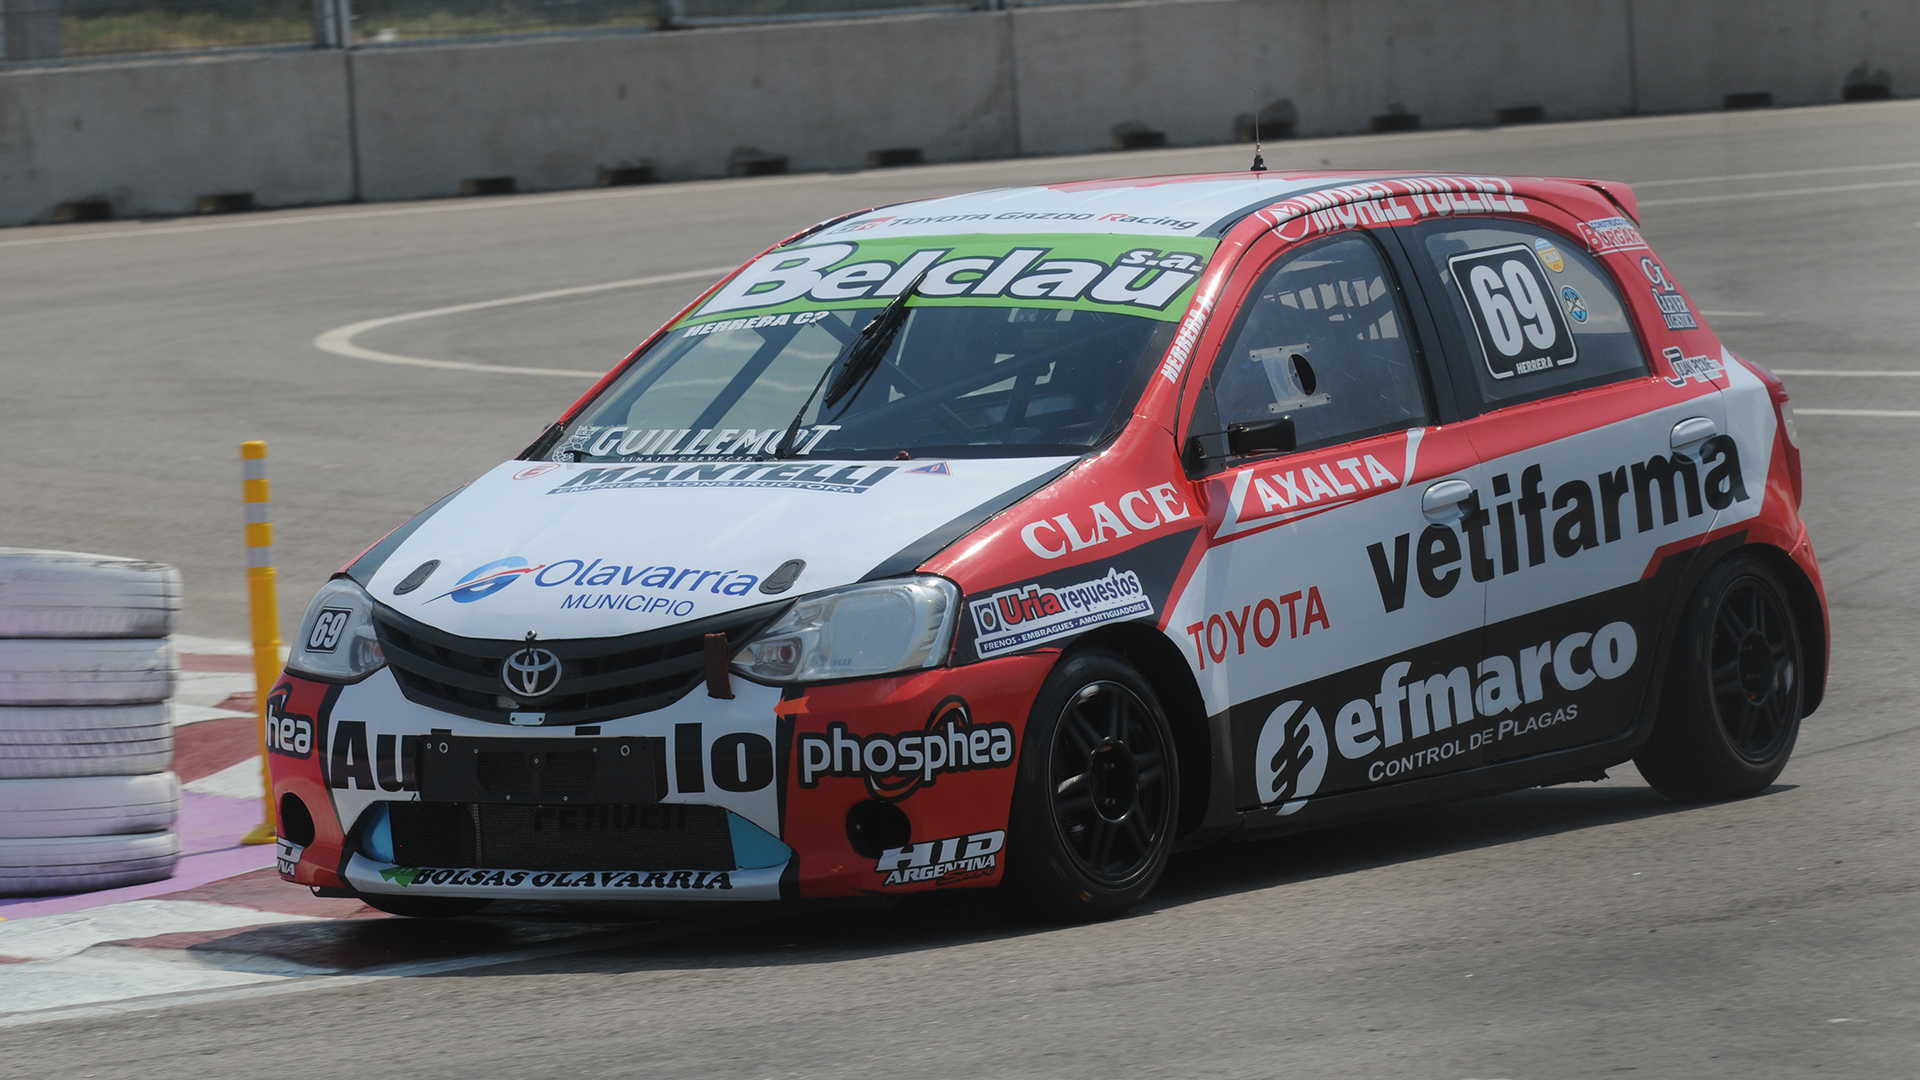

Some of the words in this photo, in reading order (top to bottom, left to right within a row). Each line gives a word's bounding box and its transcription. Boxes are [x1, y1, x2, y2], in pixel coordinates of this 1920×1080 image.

[890, 213, 989, 229] TOYOTA
[993, 211, 1097, 222] GAZOO
[1097, 212, 1200, 231] Racing
[1296, 180, 1413, 234] MOREL
[690, 242, 1199, 318] Belclau
[1120, 248, 1204, 273] s.a.
[682, 314, 791, 339] HERRERA
[1470, 259, 1557, 357] 69
[1159, 309, 1208, 385] HERRERA
[1515, 356, 1554, 375] HERRERA
[589, 425, 842, 457] GUILLEMOT
[553, 480, 656, 494] EMPRESA
[664, 480, 857, 493] CONSTRUCTORA
[557, 463, 900, 488] MANTELLI
[1254, 454, 1399, 513] AXALTA
[1020, 481, 1191, 560] CLACE
[1365, 435, 1750, 613] vetifarma
[533, 558, 759, 598] Olavarría
[1059, 573, 1140, 612] repuestos
[560, 593, 696, 617] MUNICIPIO
[309, 611, 348, 648] 69
[983, 637, 1018, 651] FRENOS
[1021, 620, 1075, 642] EMBRAGUES
[1079, 602, 1147, 627] AMORTIGUADORES
[1186, 585, 1331, 670] TOYOTA
[1334, 621, 1638, 760] efmarco
[803, 722, 1013, 784] phosphea
[1368, 739, 1466, 783] CONTROL
[1469, 728, 1494, 751] DE
[1497, 704, 1579, 741] PLAGAS
[875, 829, 1006, 872] HID
[884, 854, 997, 885] ARGENTINA
[411, 868, 535, 887] BOLSAS
[531, 870, 734, 890] OLAVARRIA
